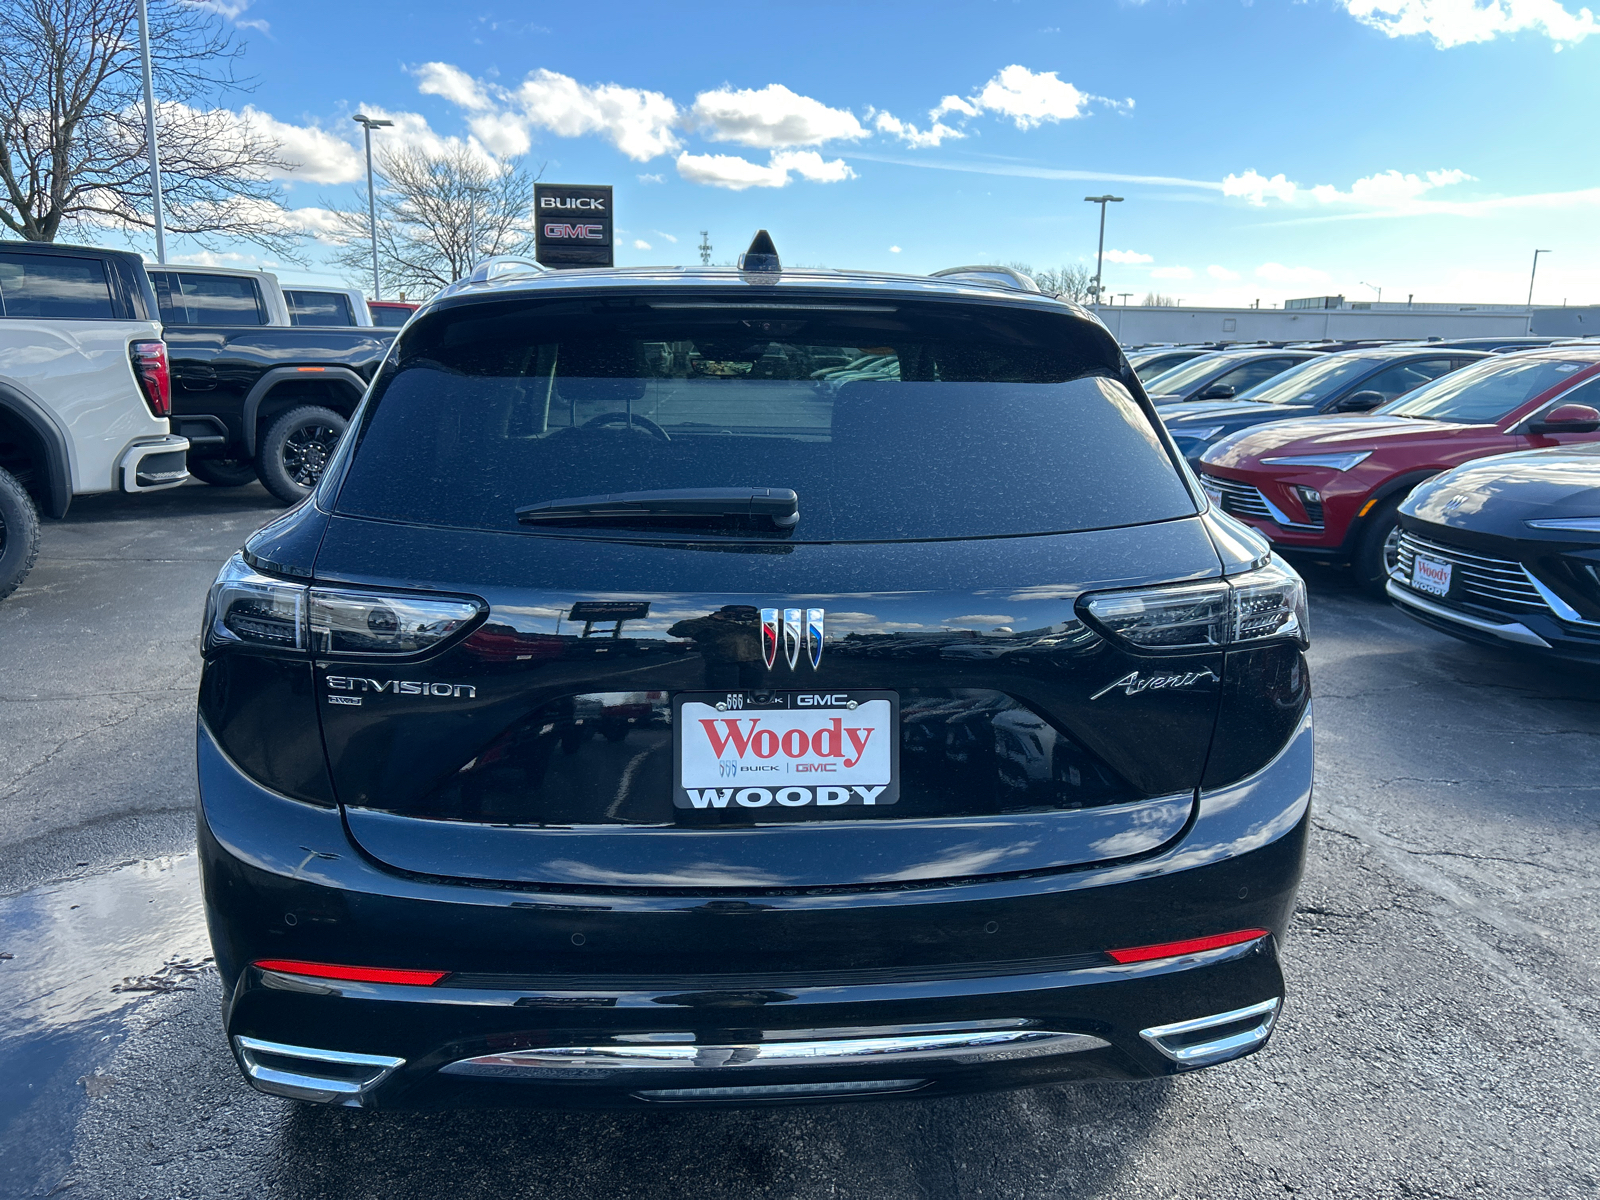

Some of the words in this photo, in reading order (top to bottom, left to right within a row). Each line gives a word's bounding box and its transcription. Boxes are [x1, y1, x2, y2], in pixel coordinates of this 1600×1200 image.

[540, 197, 605, 210] BUICK
[544, 223, 603, 239] GMC
[1418, 561, 1450, 585] Woody
[1411, 579, 1449, 598] WOODY
[1089, 665, 1220, 700] Avenir
[797, 694, 848, 706] GMC
[698, 718, 875, 768] Woody
[795, 763, 837, 772] GMC
[686, 786, 887, 809] WOODY
